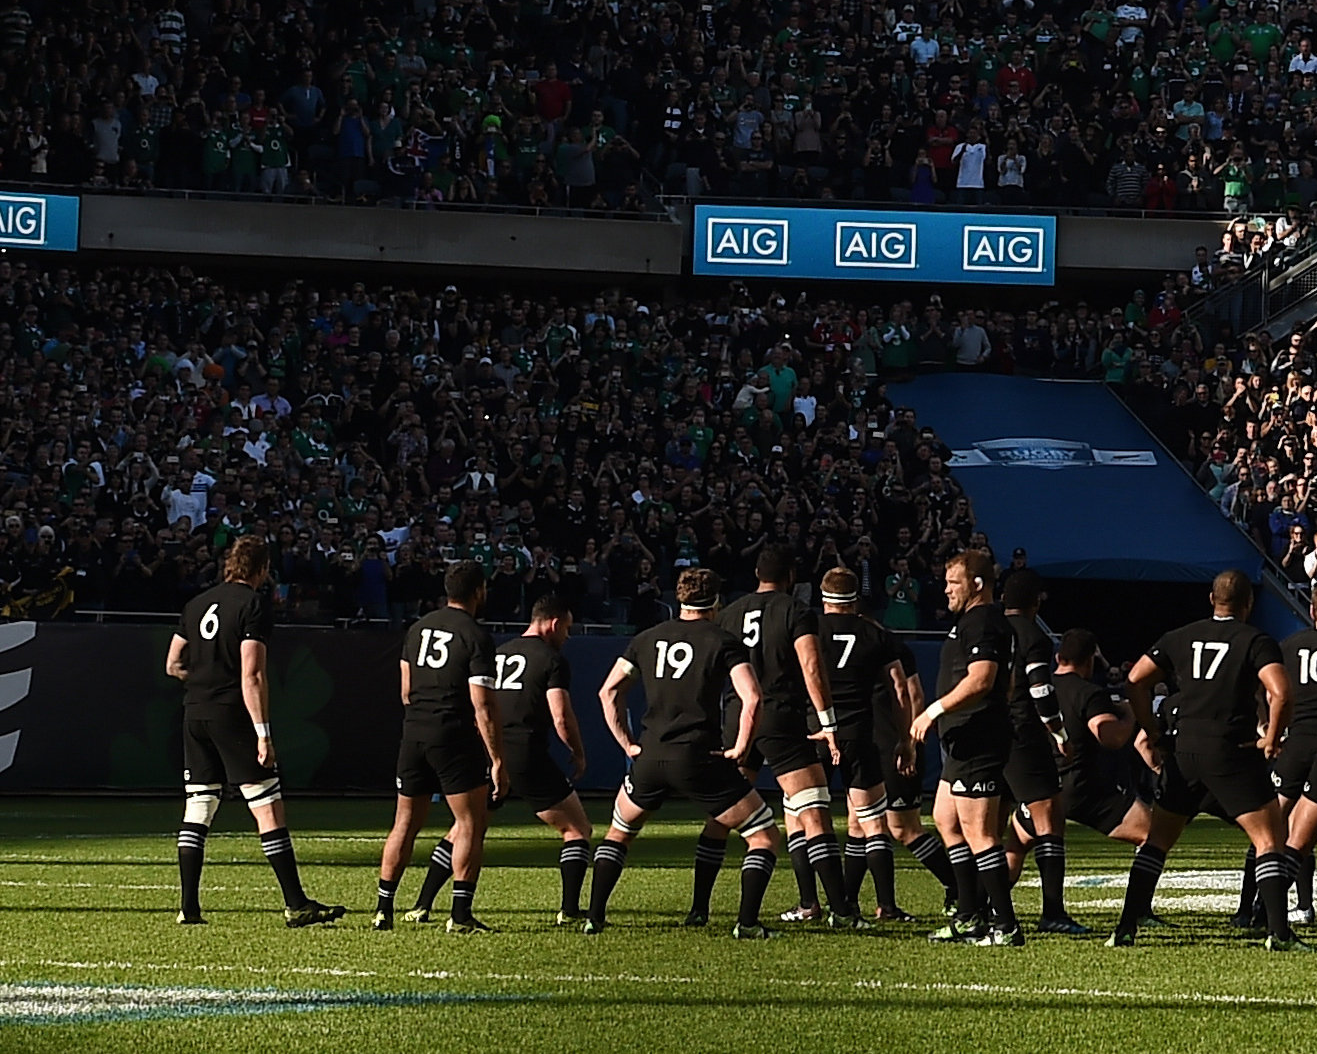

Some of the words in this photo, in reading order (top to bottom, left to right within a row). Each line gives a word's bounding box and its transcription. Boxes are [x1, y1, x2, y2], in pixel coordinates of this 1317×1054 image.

[716, 228, 778, 256] AIG
[844, 232, 906, 259] AIG
[971, 235, 1034, 264] AIG
[199, 603, 219, 640] 6
[742, 609, 762, 648] 5
[416, 628, 454, 669] 13
[655, 640, 694, 679] 19
[832, 633, 856, 669] 7
[1191, 641, 1230, 680] 17
[494, 654, 527, 690] 12
[972, 780, 996, 792] AIG
